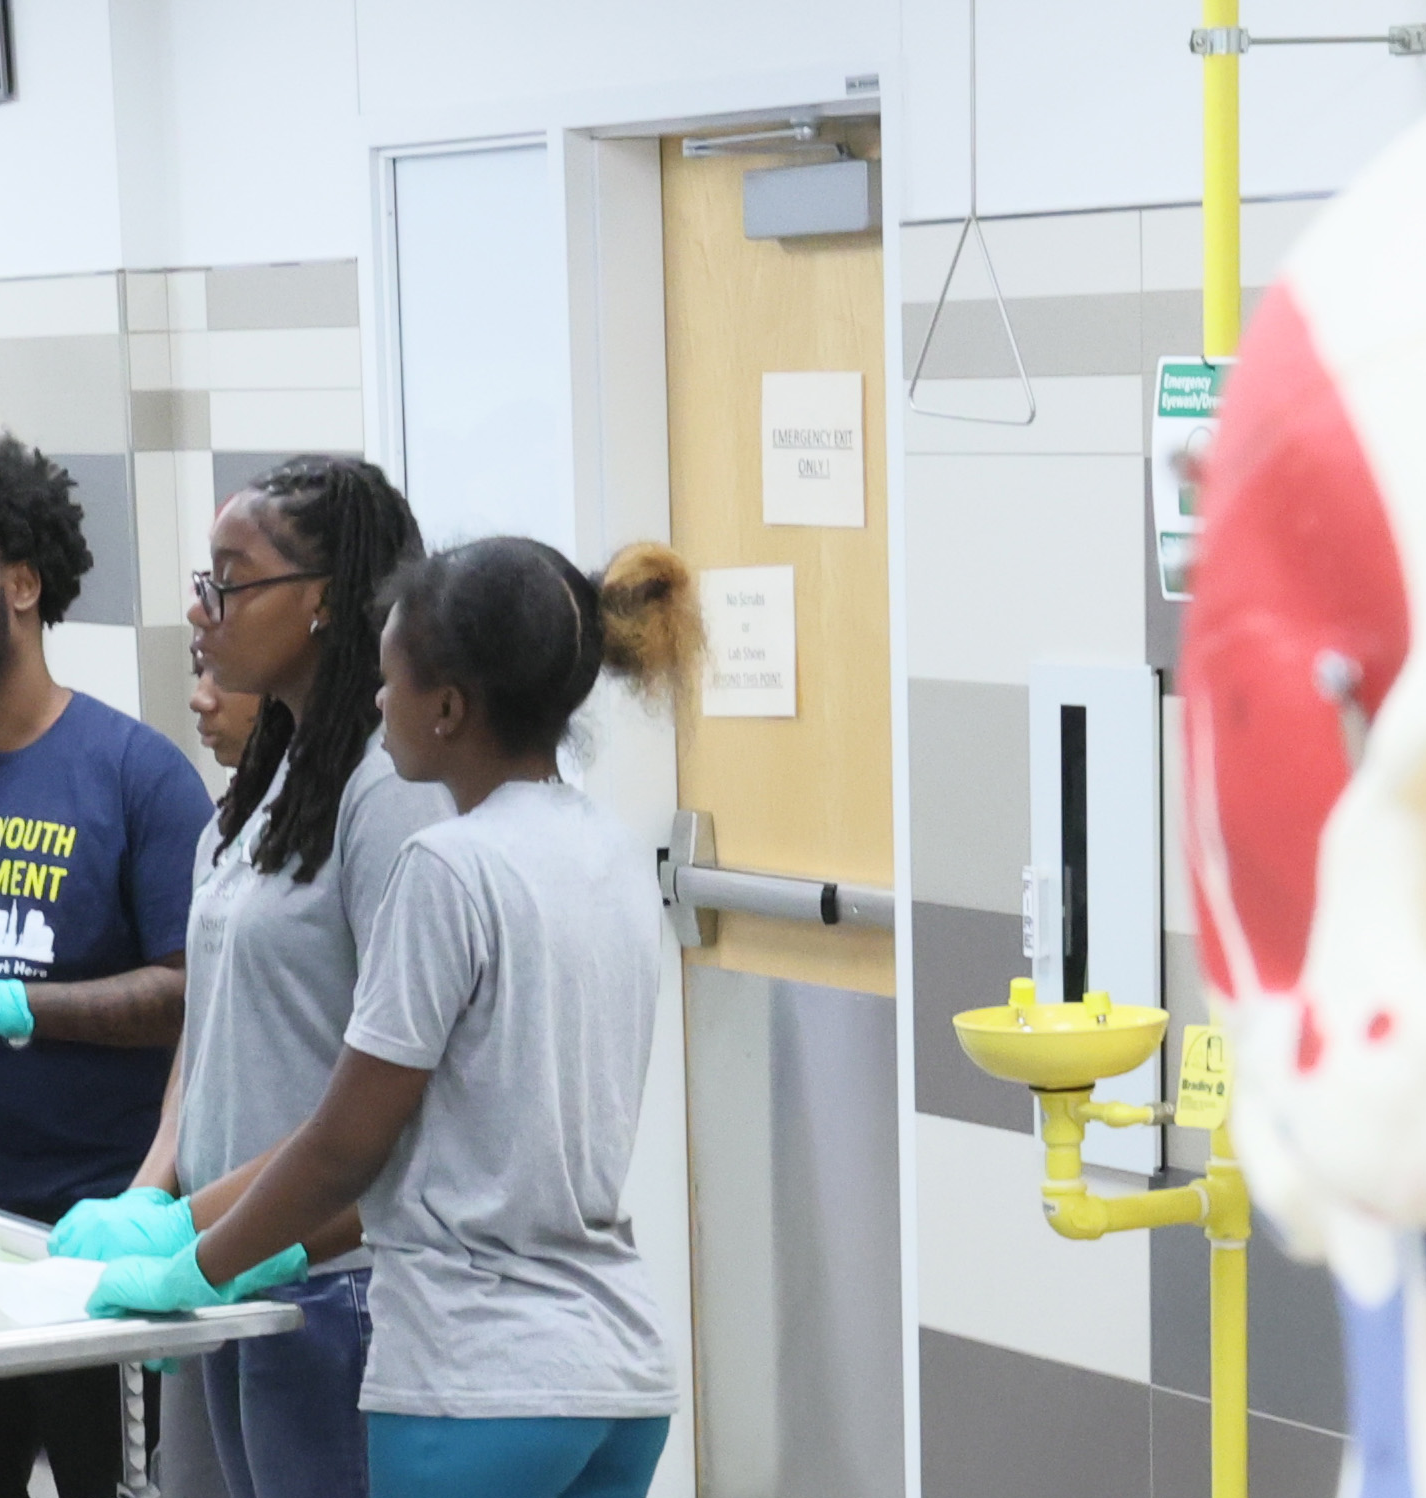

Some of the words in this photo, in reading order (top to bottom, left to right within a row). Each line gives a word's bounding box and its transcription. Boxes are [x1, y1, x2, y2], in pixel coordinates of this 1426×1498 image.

[1163, 372, 1212, 393] Emergency
[772, 427, 832, 447] EMERGENCY
[834, 428, 854, 448] EXIT
[726, 592, 738, 606] No
[739, 591, 765, 607] Scrubs
[13, 959, 48, 979] Here
[1182, 1078, 1214, 1095] Bradley
